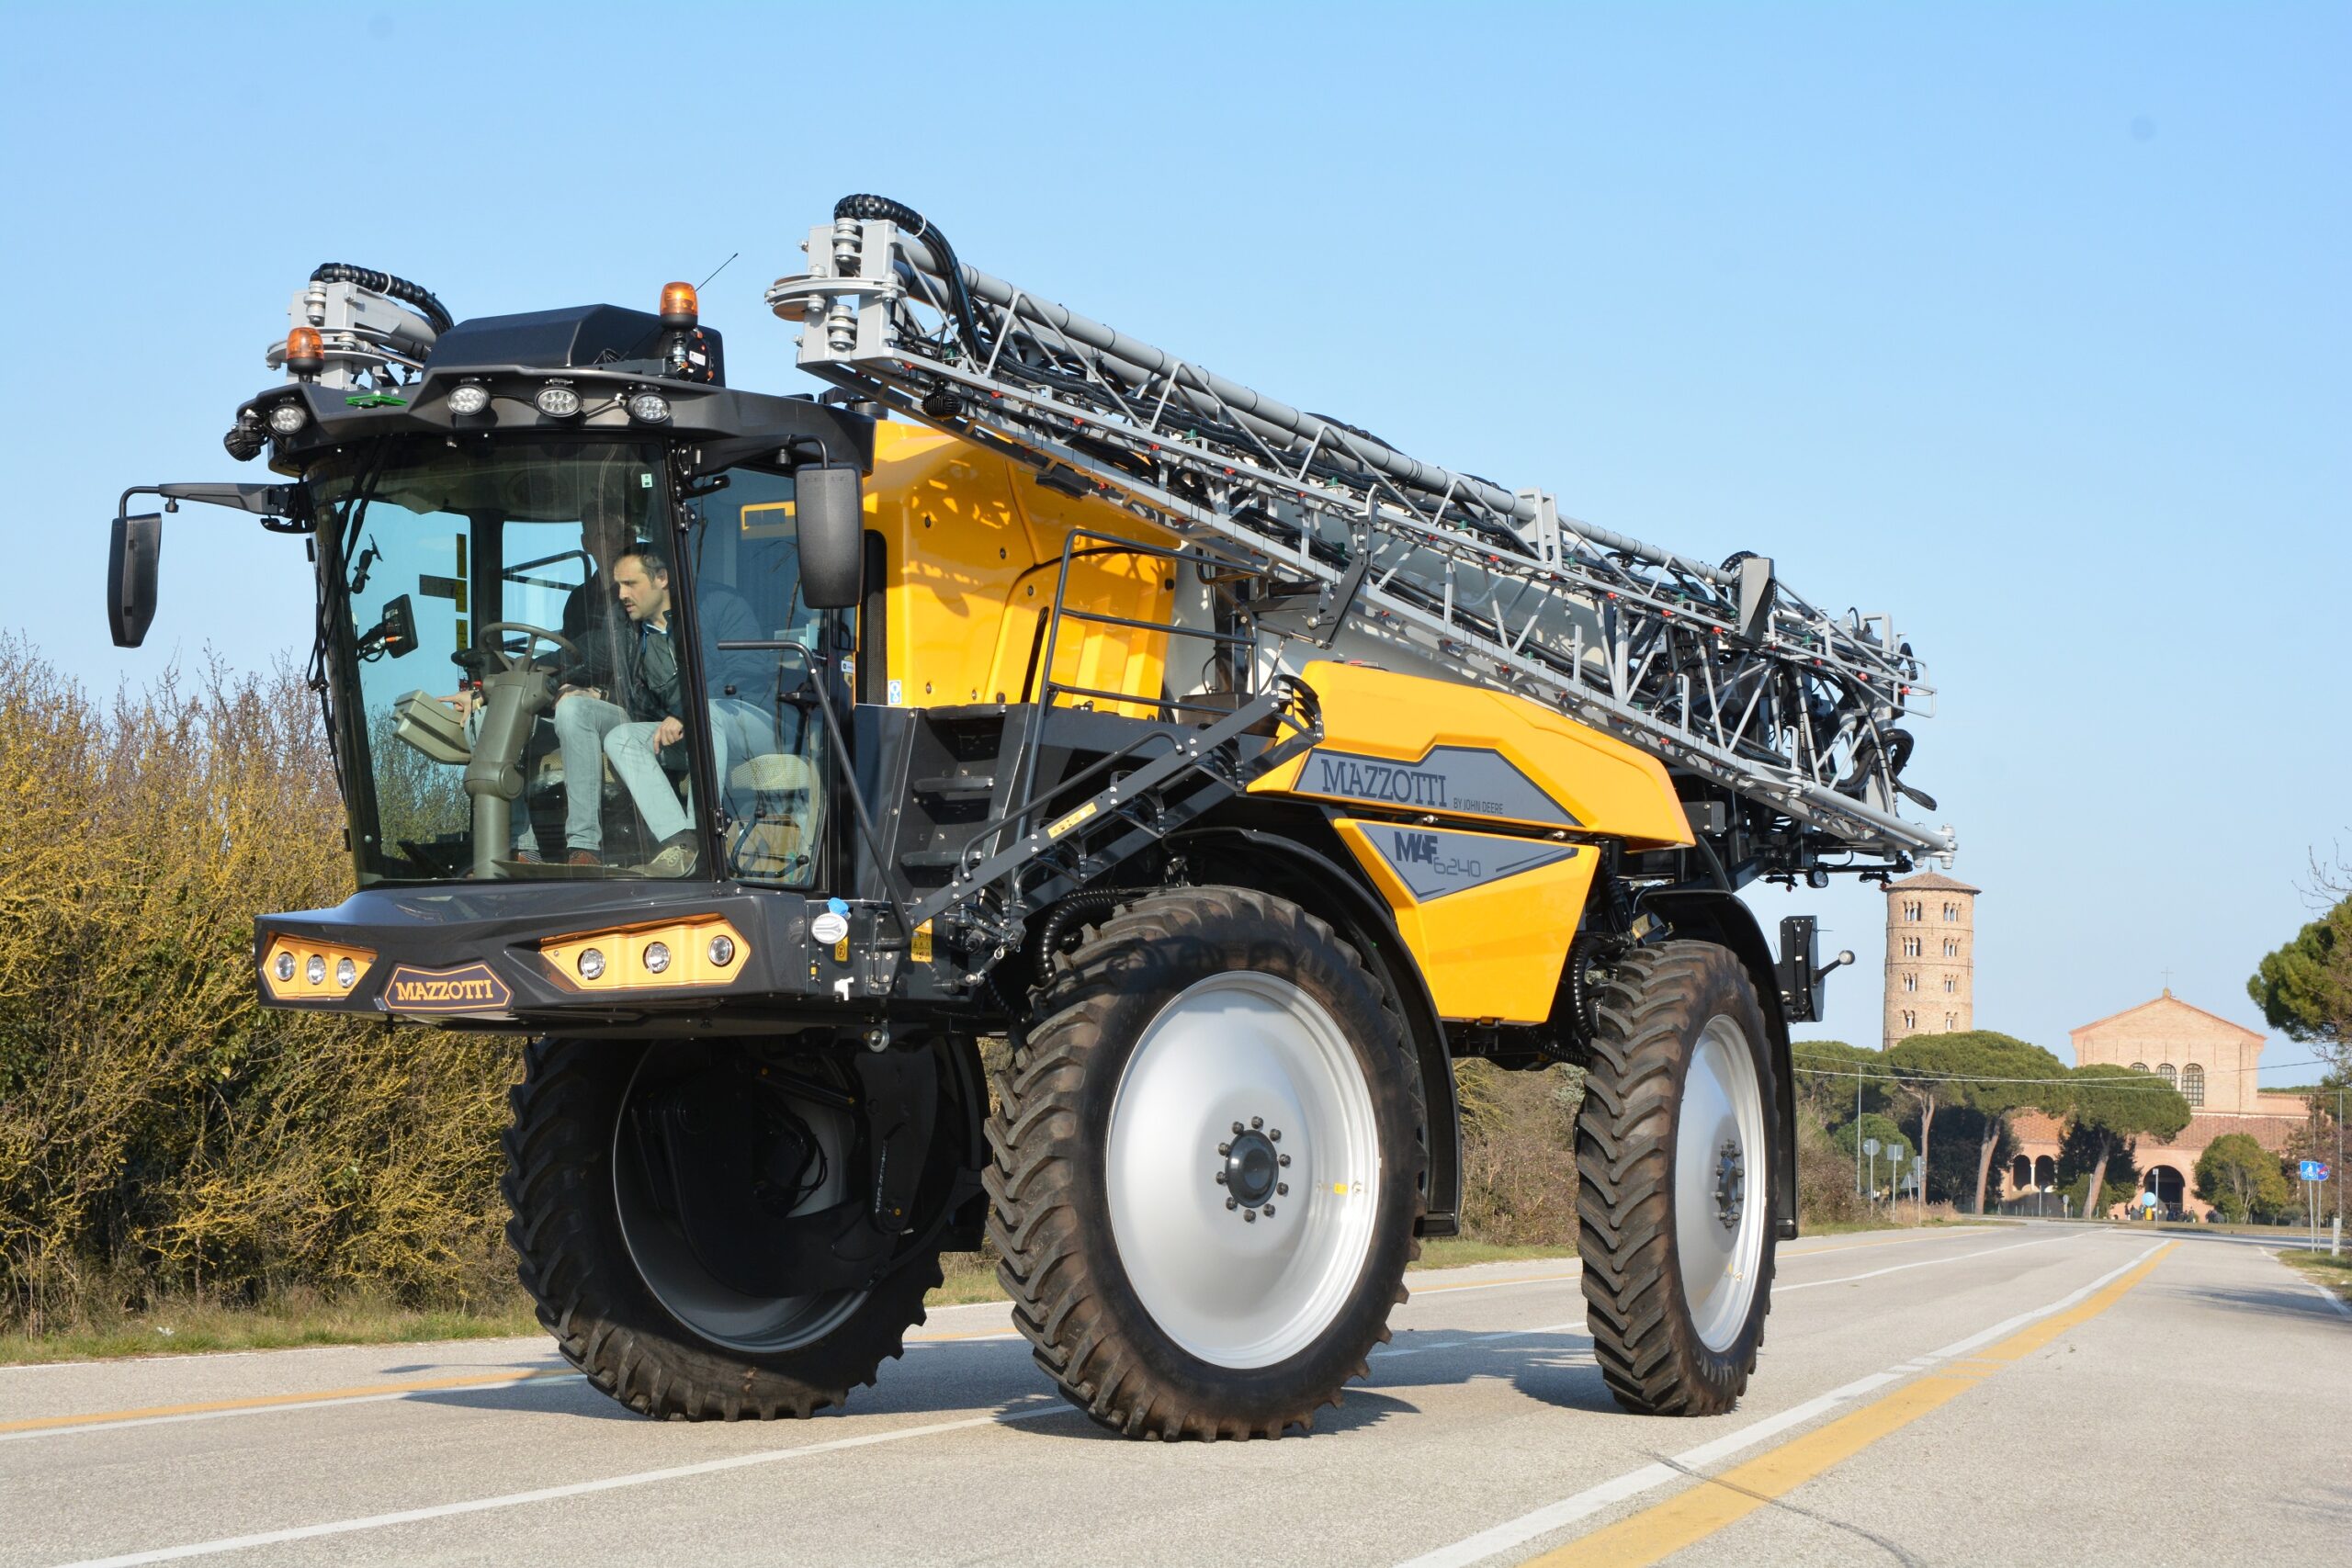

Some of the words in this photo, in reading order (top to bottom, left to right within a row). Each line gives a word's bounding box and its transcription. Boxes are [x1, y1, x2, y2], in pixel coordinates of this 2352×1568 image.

[1321, 758, 1447, 807] MAZZOTTI
[1453, 797, 1463, 808] BY
[1464, 799, 1480, 812] JOHN
[1482, 801, 1503, 814] DEERE
[1394, 830, 1438, 864] MAF
[1433, 856, 1481, 877] 6240
[395, 979, 494, 1001] MAZZOTTI
